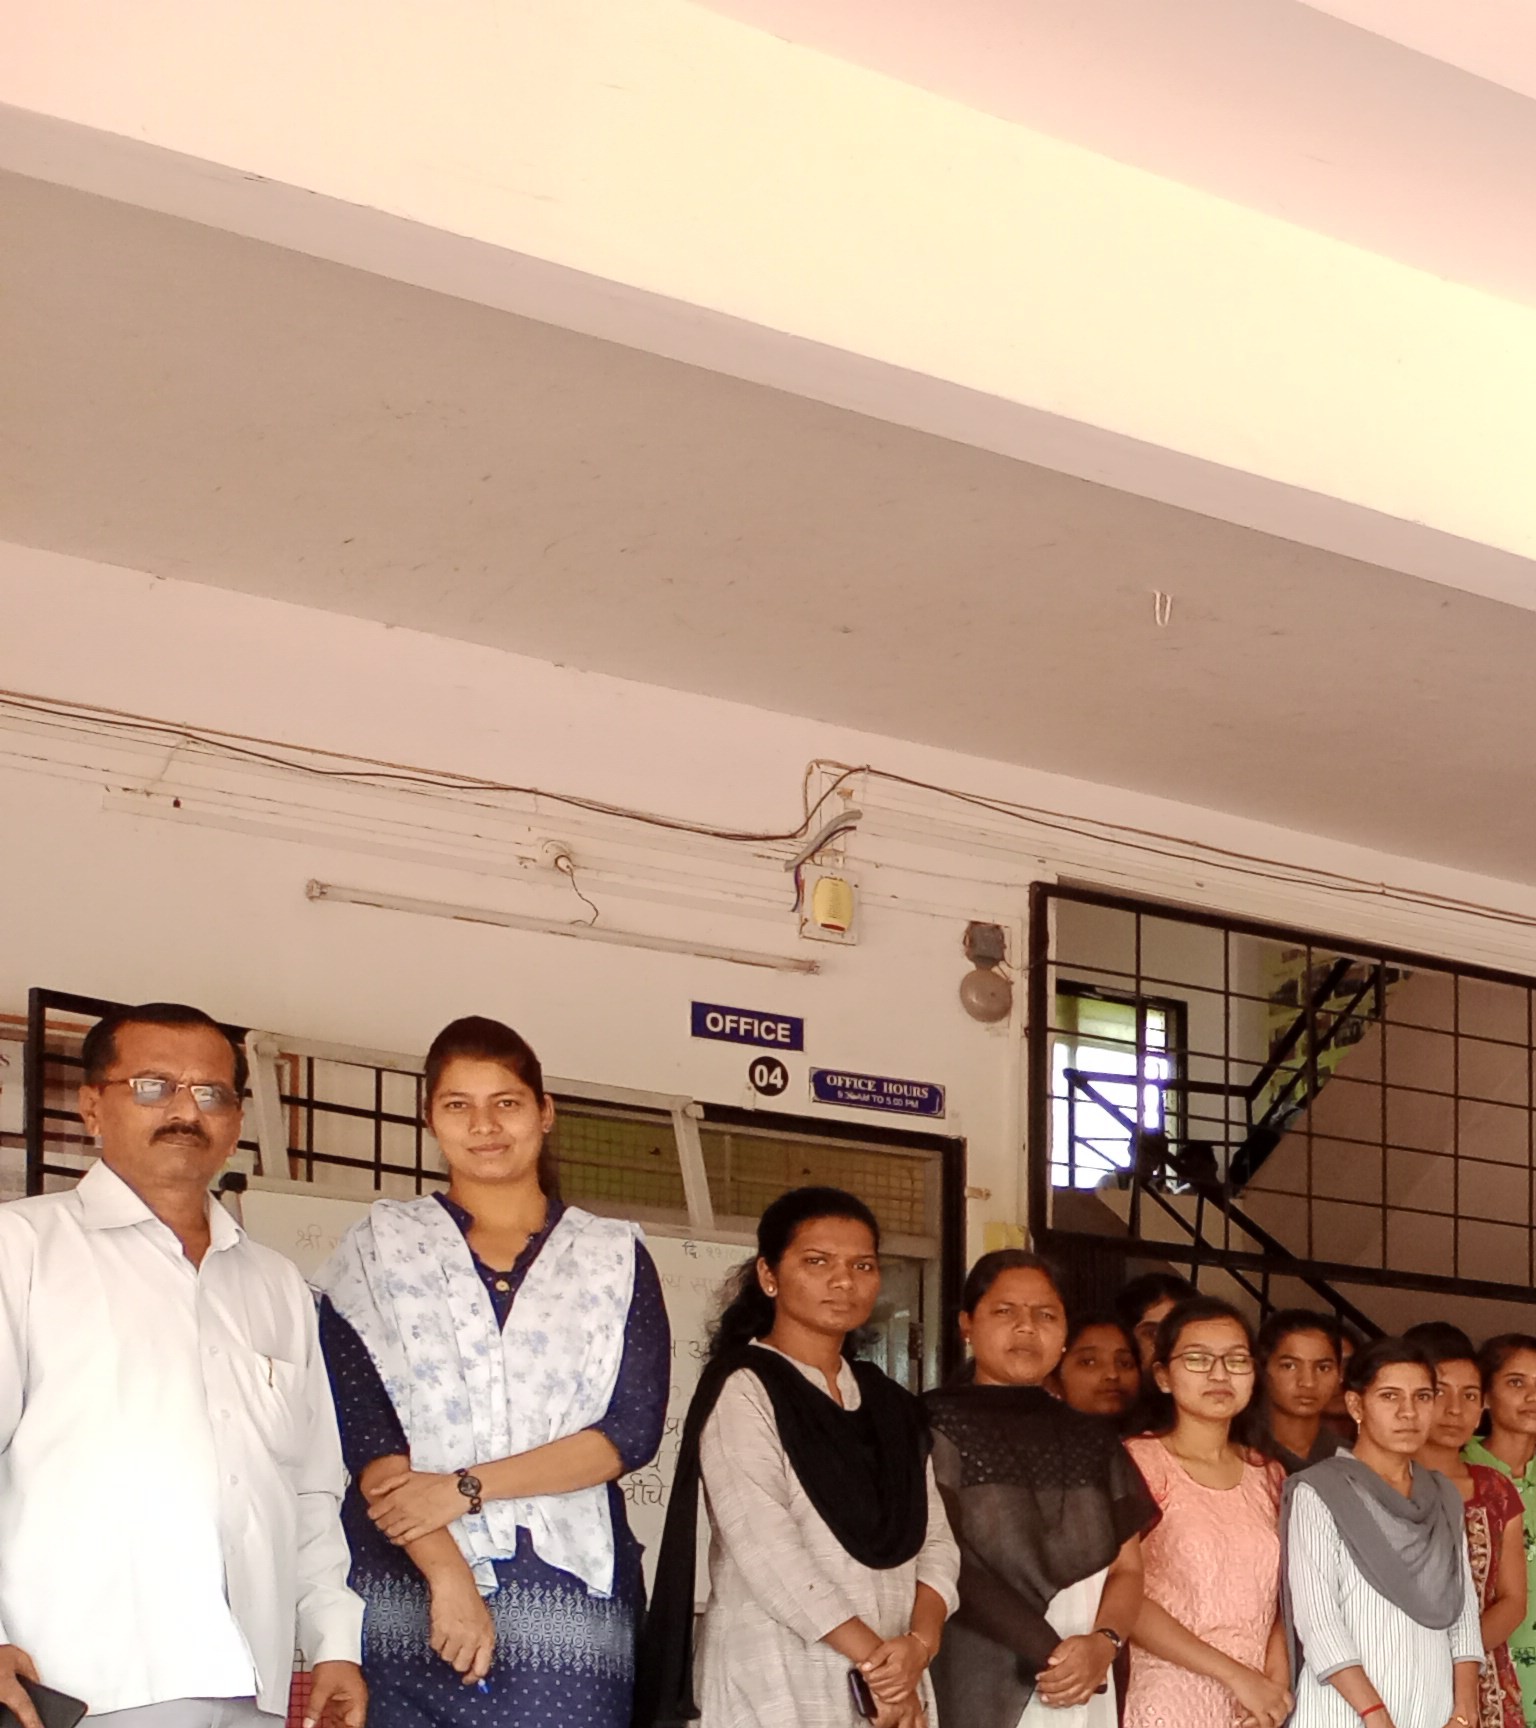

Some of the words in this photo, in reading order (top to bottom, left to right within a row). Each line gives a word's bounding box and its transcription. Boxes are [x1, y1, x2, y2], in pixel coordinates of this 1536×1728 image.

[706, 1012, 791, 1043] OFFICE
[754, 1065, 784, 1089] 04
[826, 1074, 876, 1092] OFFICE
[883, 1081, 929, 1099] HOURS
[905, 1099, 919, 1108] PM
